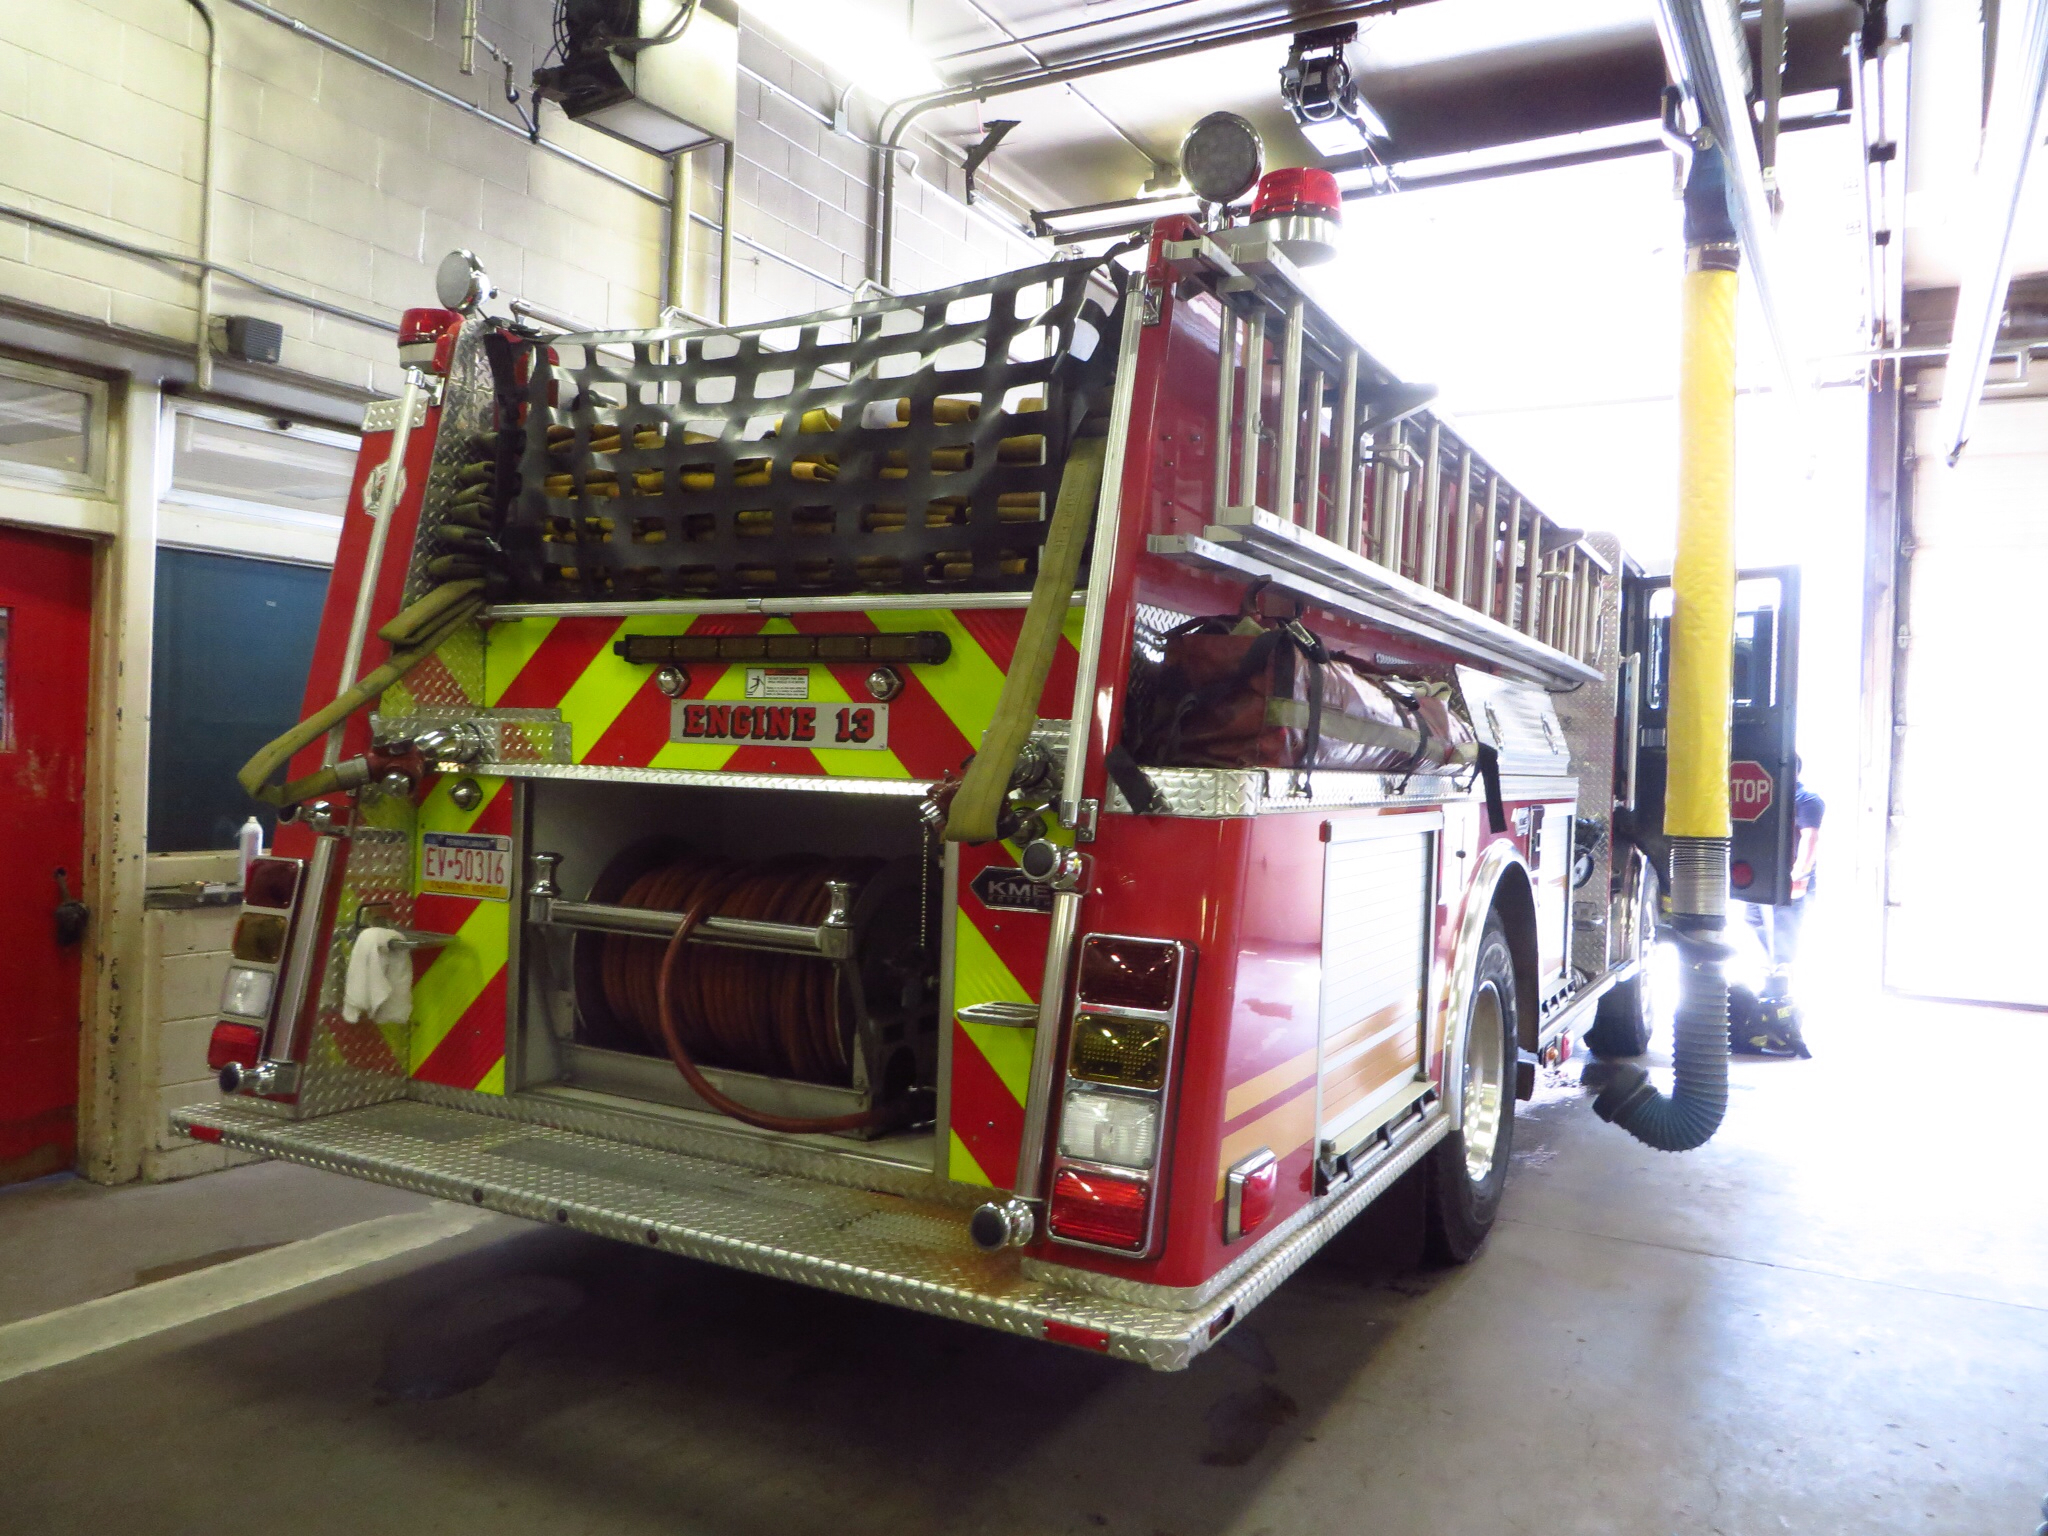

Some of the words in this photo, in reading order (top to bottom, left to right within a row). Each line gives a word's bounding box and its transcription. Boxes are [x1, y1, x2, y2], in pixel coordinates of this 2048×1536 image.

[683, 704, 817, 742] ENGINE
[835, 707, 876, 743] 13
[1731, 778, 1770, 803] TOP
[988, 880, 1051, 898] KME
